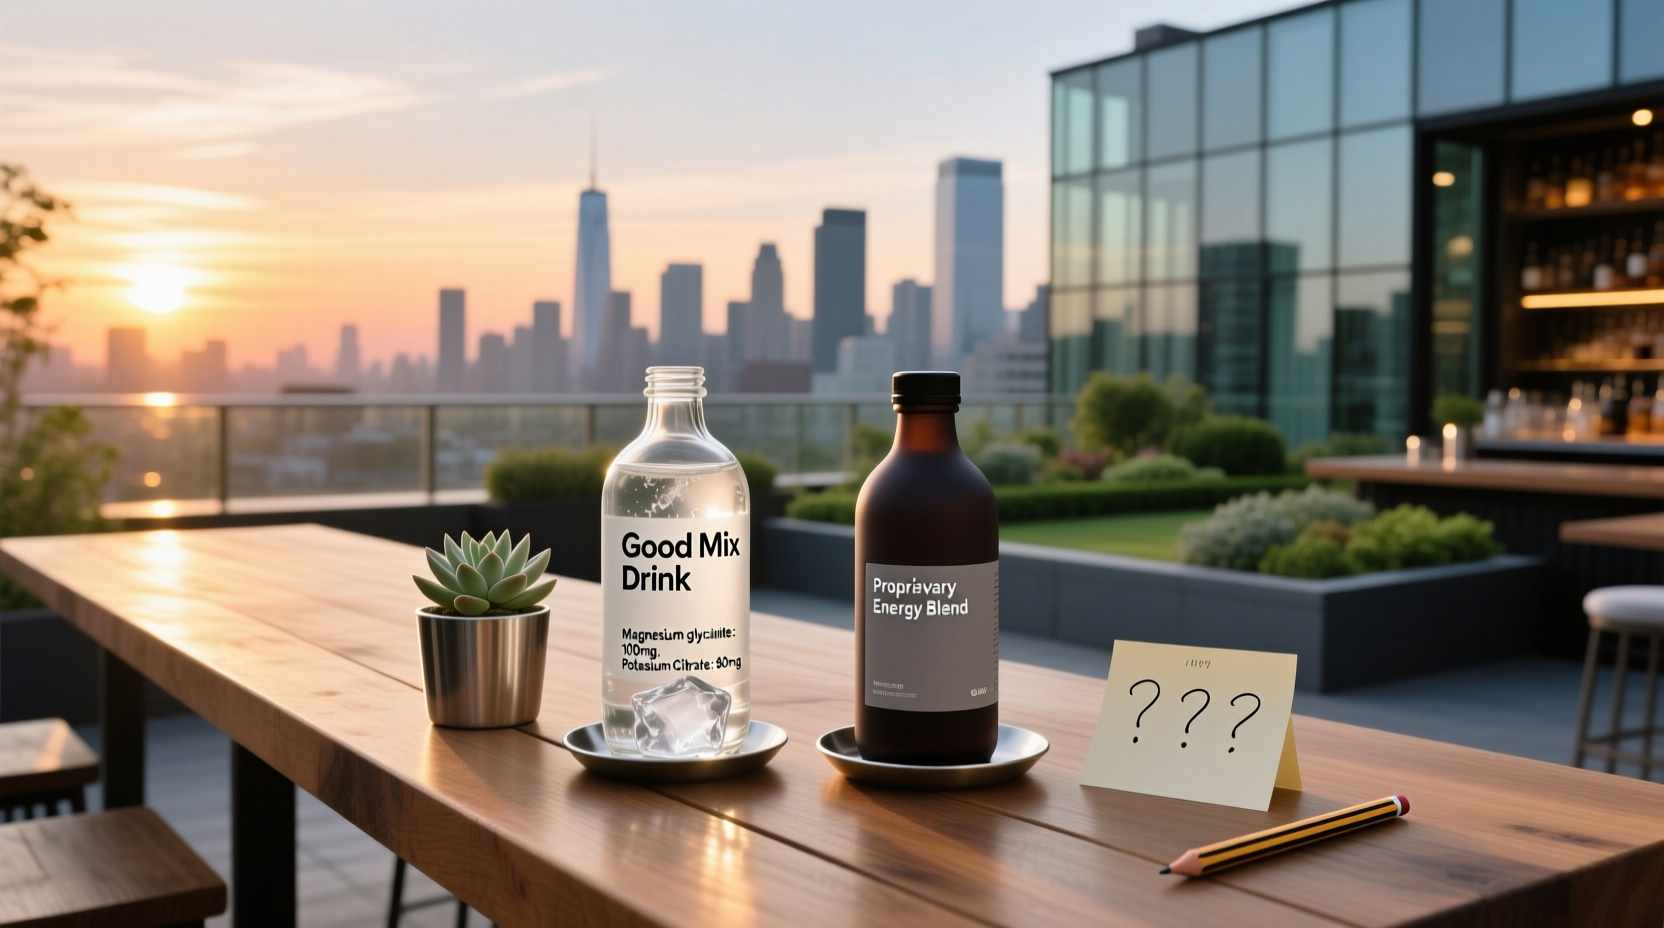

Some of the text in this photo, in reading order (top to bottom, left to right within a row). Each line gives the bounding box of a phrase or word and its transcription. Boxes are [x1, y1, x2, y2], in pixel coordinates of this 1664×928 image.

[622, 531, 741, 559] Good Mix
[622, 564, 692, 592] Drink
[873, 598, 969, 621] Energy Blend
[622, 628, 684, 644] Magnesium
